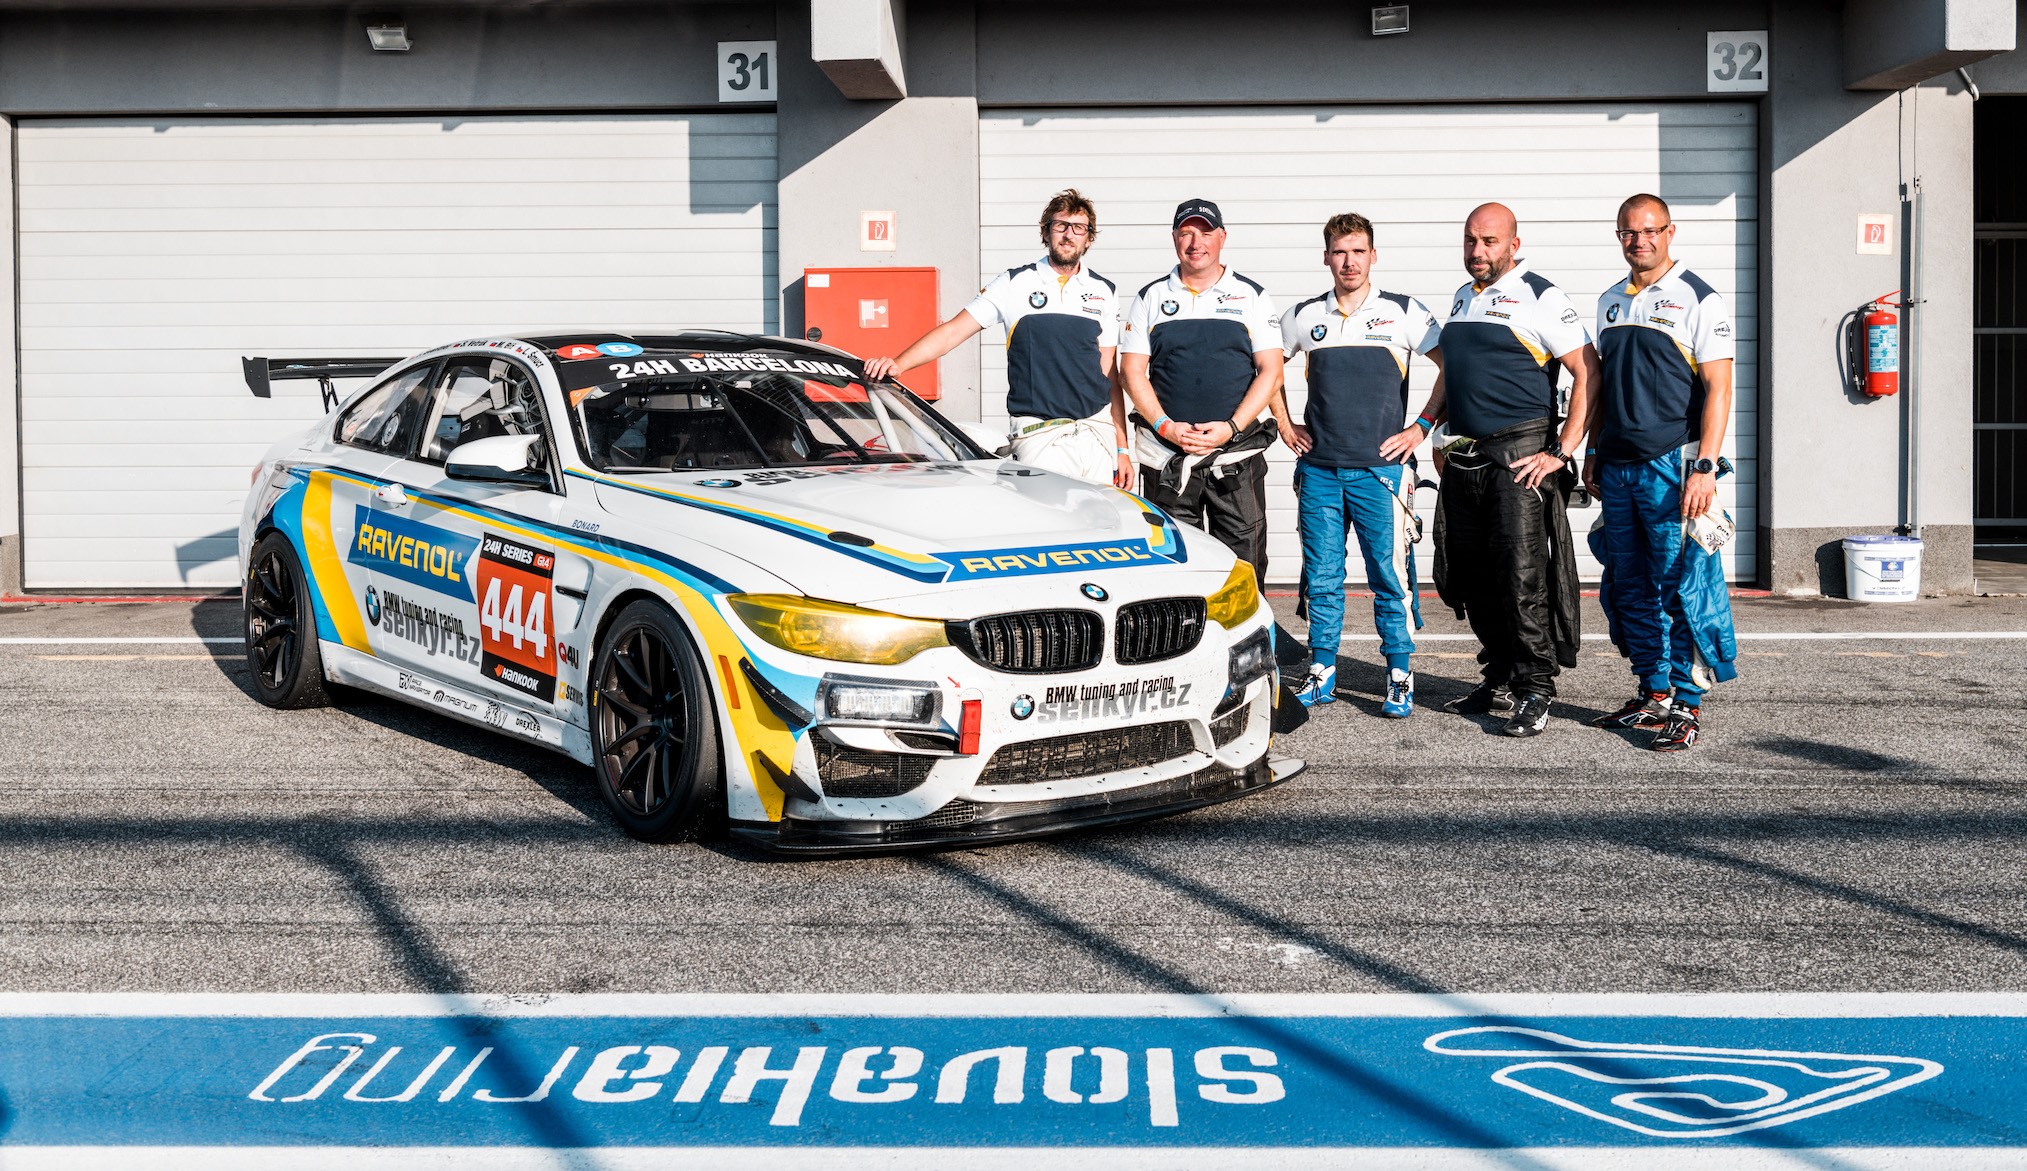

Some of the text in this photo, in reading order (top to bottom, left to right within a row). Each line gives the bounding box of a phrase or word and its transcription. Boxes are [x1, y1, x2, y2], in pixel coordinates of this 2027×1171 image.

[727, 52, 769, 90] 31
[1713, 41, 1763, 81] 32
[571, 346, 597, 356] A
[606, 345, 632, 353] B
[609, 357, 860, 379] 24H BARCELONA
[572, 519, 600, 532] BONARD
[357, 523, 461, 583] RAVENOL
[483, 539, 502, 555] 24H
[502, 544, 534, 565] SERIES
[960, 545, 1152, 573] RAVENOL
[383, 590, 464, 641] BMW tuning and racing
[481, 576, 548, 659] 444
[1046, 675, 1174, 704] BMW tuning and racing
[515, 716, 541, 733] DREXLER
